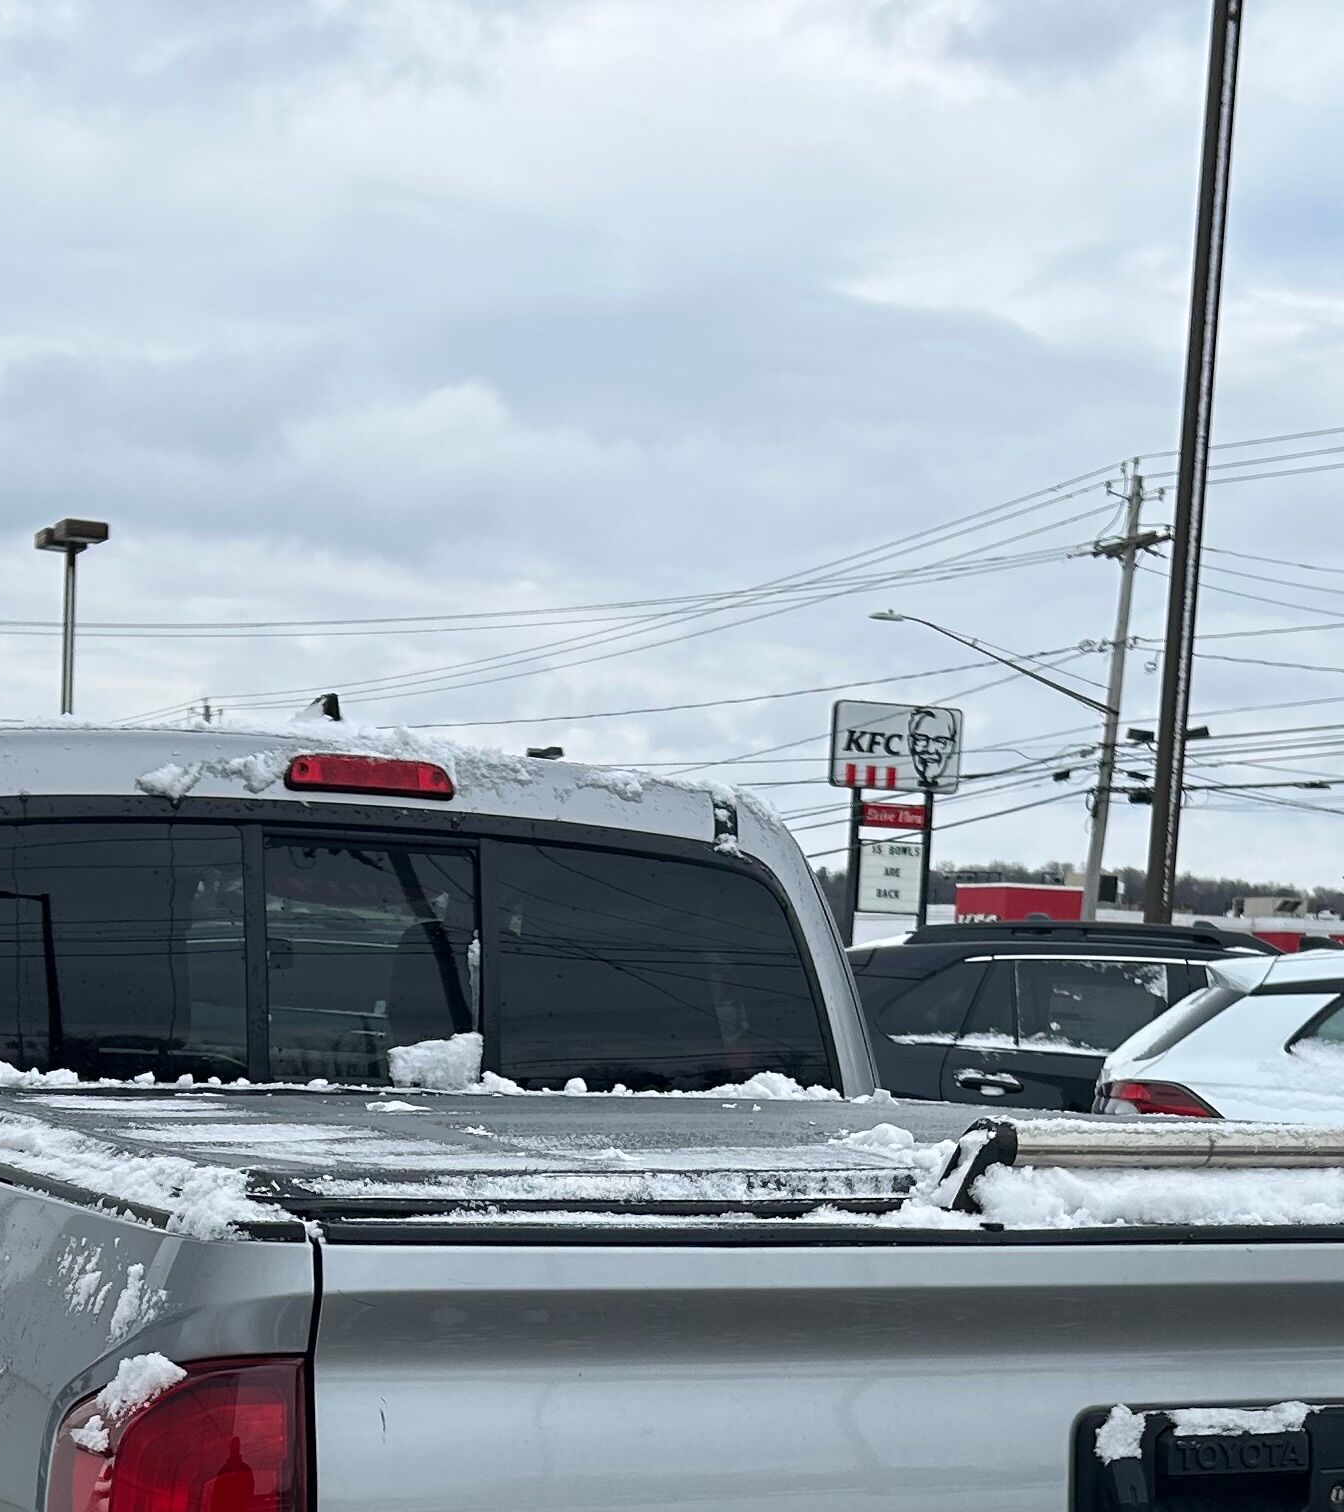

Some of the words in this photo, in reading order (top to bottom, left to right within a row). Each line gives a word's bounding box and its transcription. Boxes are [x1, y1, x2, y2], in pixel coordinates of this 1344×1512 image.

[843, 729, 903, 755] KFC
[884, 867, 901, 878] ARE
[875, 888, 900, 899] BACK
[1175, 1439, 1305, 1472] TOYOTA
